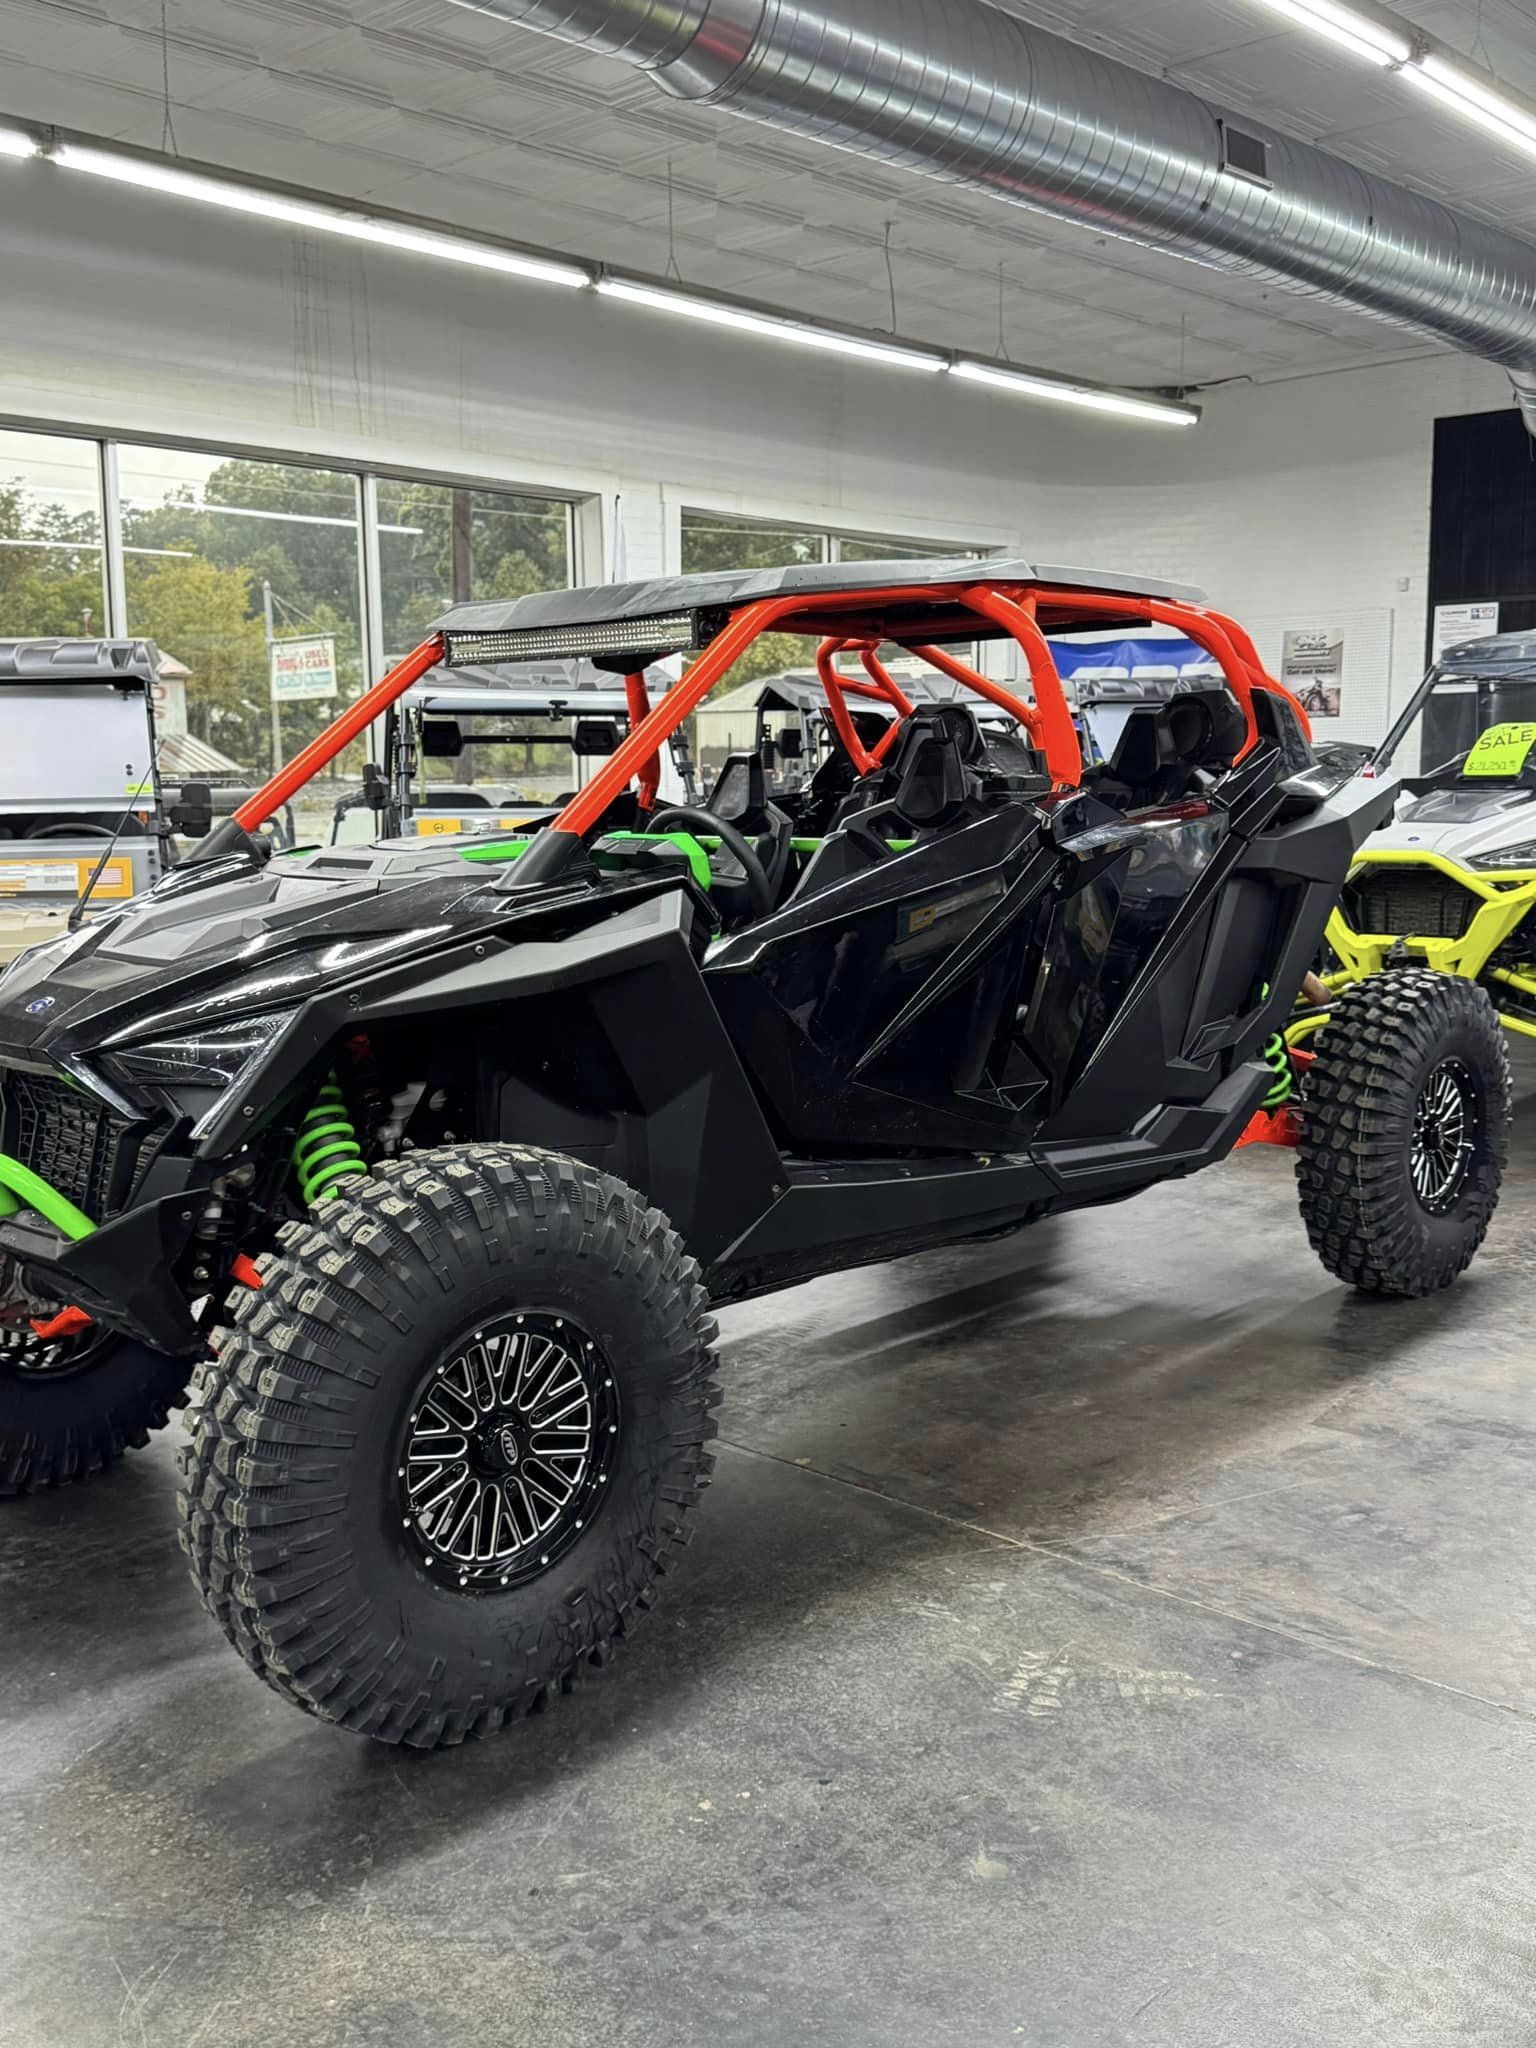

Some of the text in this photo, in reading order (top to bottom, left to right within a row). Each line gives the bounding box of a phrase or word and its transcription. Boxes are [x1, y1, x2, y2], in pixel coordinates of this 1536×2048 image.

[304, 649, 330, 659] USED
[304, 658, 330, 669] CARS
[1479, 729, 1534, 751] SALE
[503, 1436, 516, 1458] ITP
